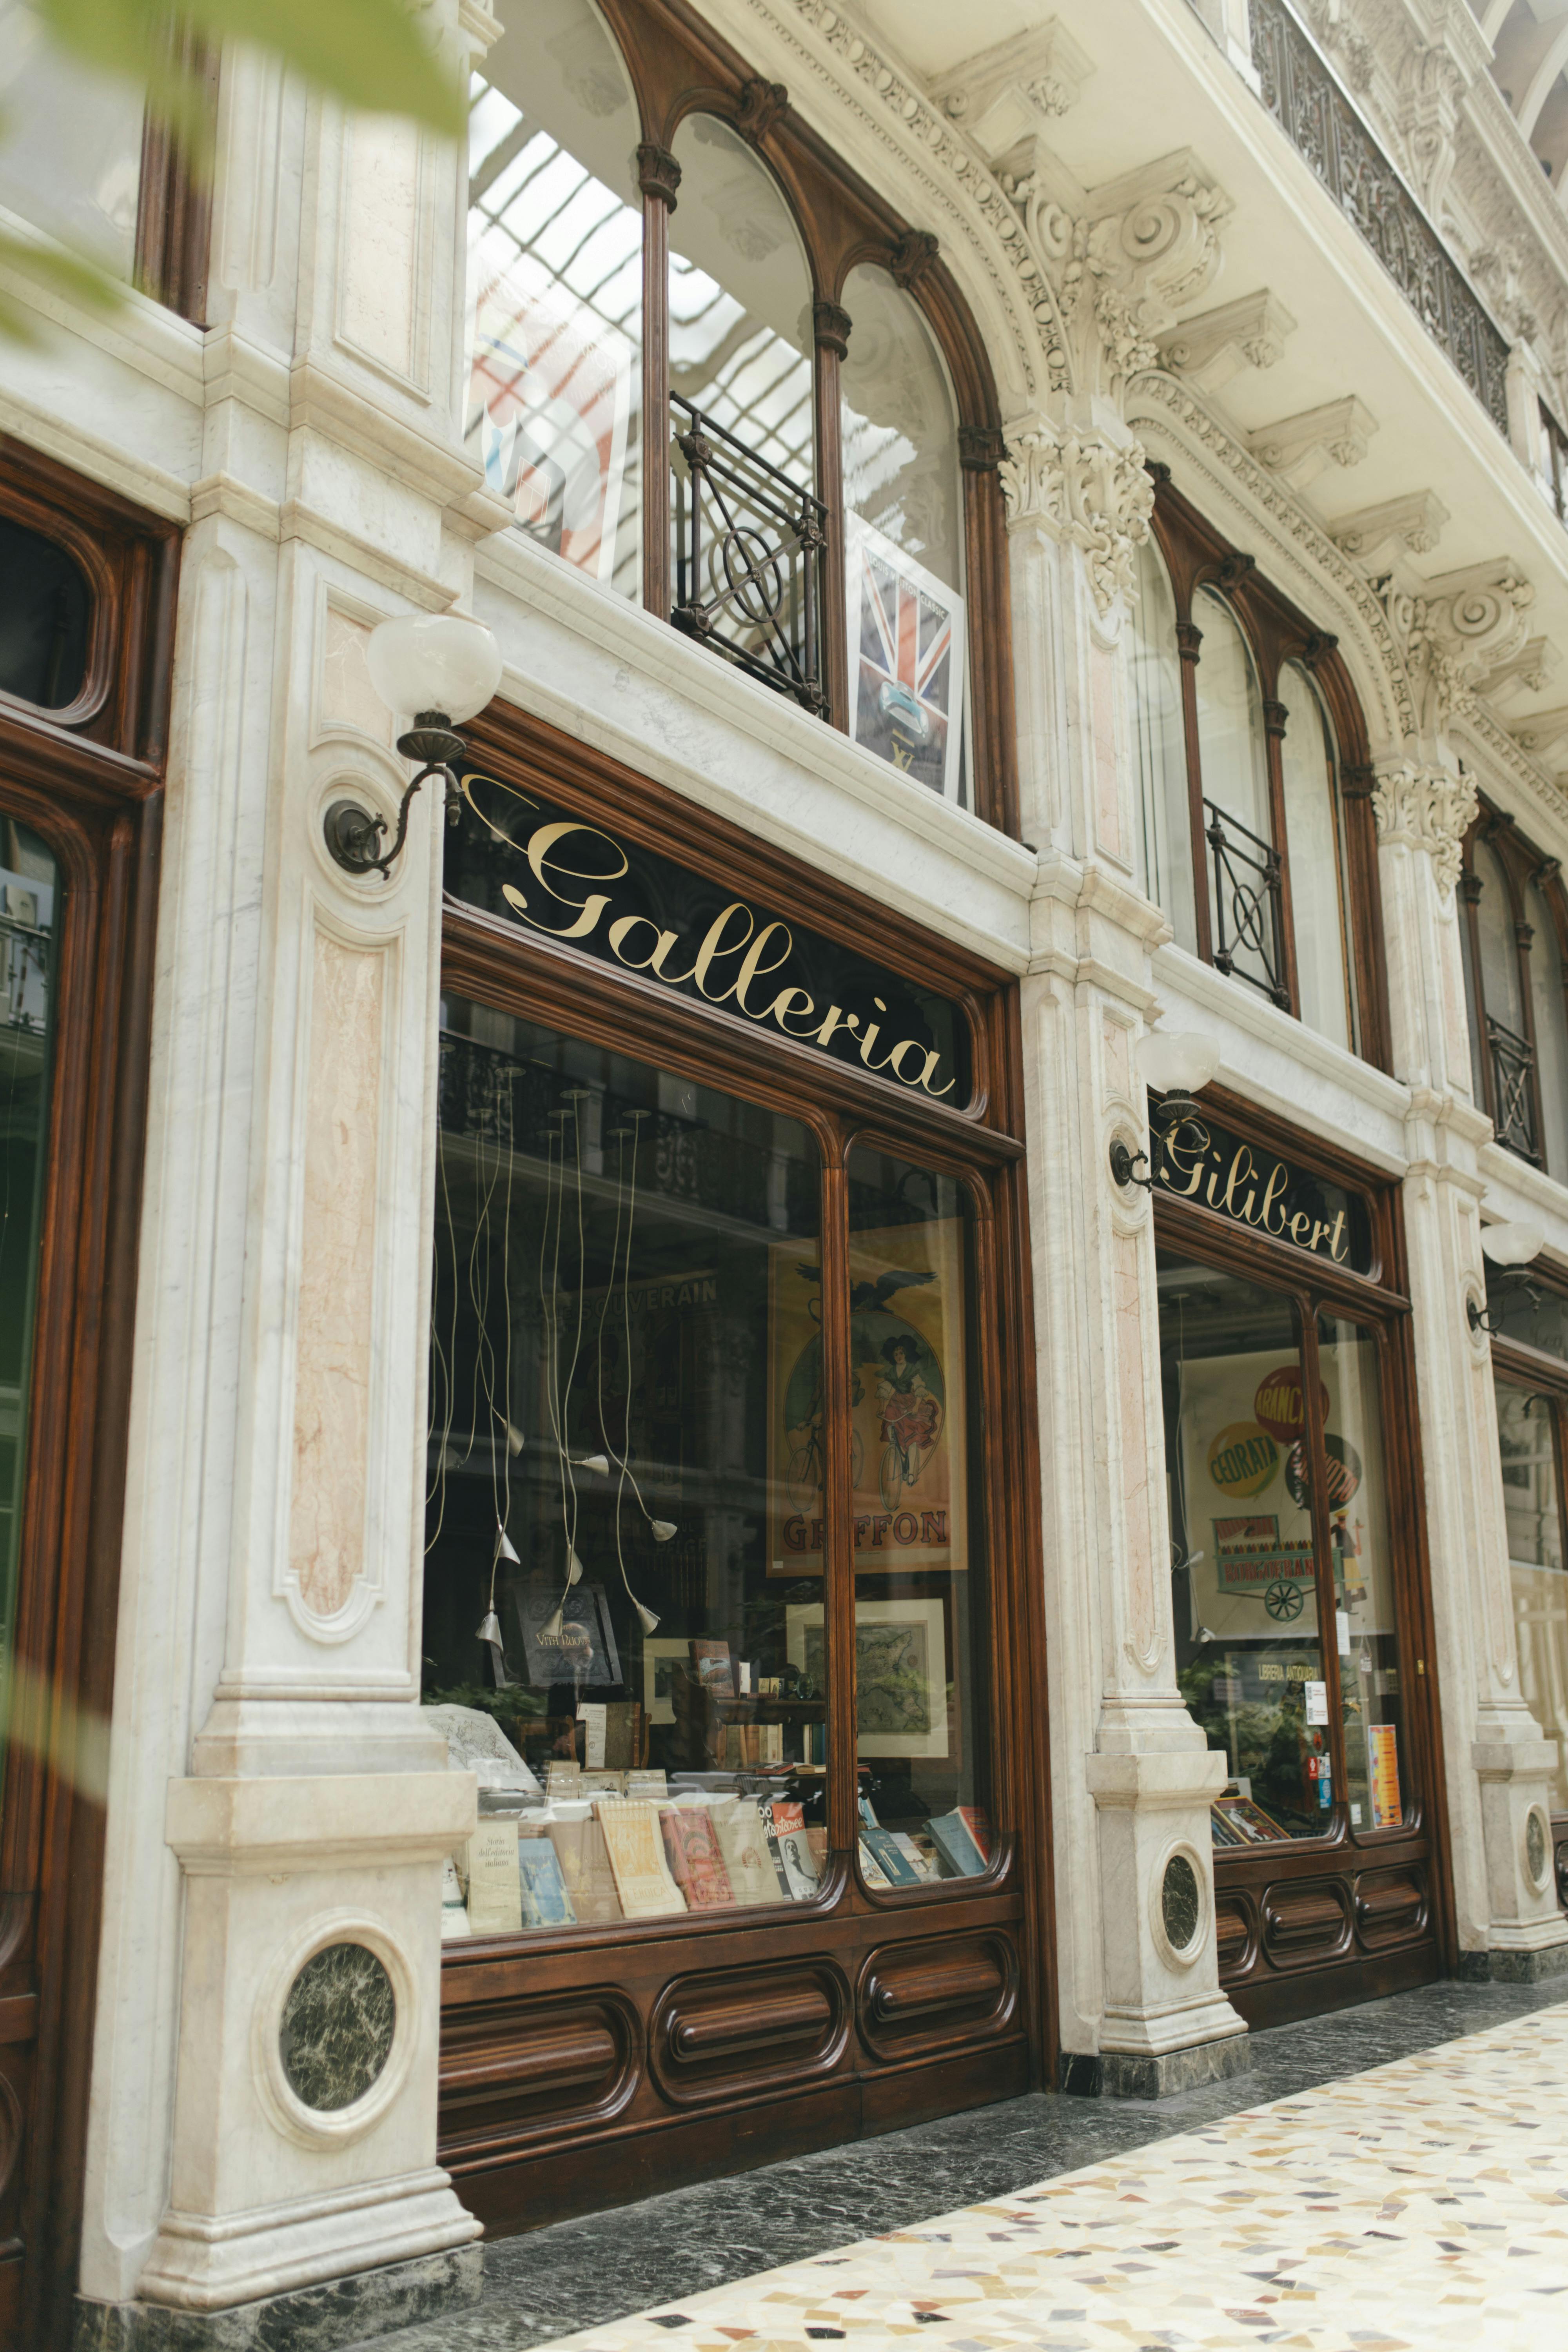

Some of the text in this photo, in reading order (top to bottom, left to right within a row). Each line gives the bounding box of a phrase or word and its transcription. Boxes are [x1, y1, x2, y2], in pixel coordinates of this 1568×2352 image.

[869, 554, 889, 576] LOUIS
[920, 595, 945, 619] CLASSIC
[461, 774, 955, 1095] Galleria
[1149, 1107, 1348, 1262] Gilibert
[581, 1279, 717, 1321] SOUVERAIN
[1210, 1435, 1278, 1485] CEDRATA
[783, 1510, 946, 1551] GRFFON
[1258, 1664, 1319, 1681] LIBRERIA ANTIQUARIA
[478, 1846, 515, 1857] dell'editoria
[486, 1837, 505, 1846] Storia
[485, 1858, 509, 1867] italiana
